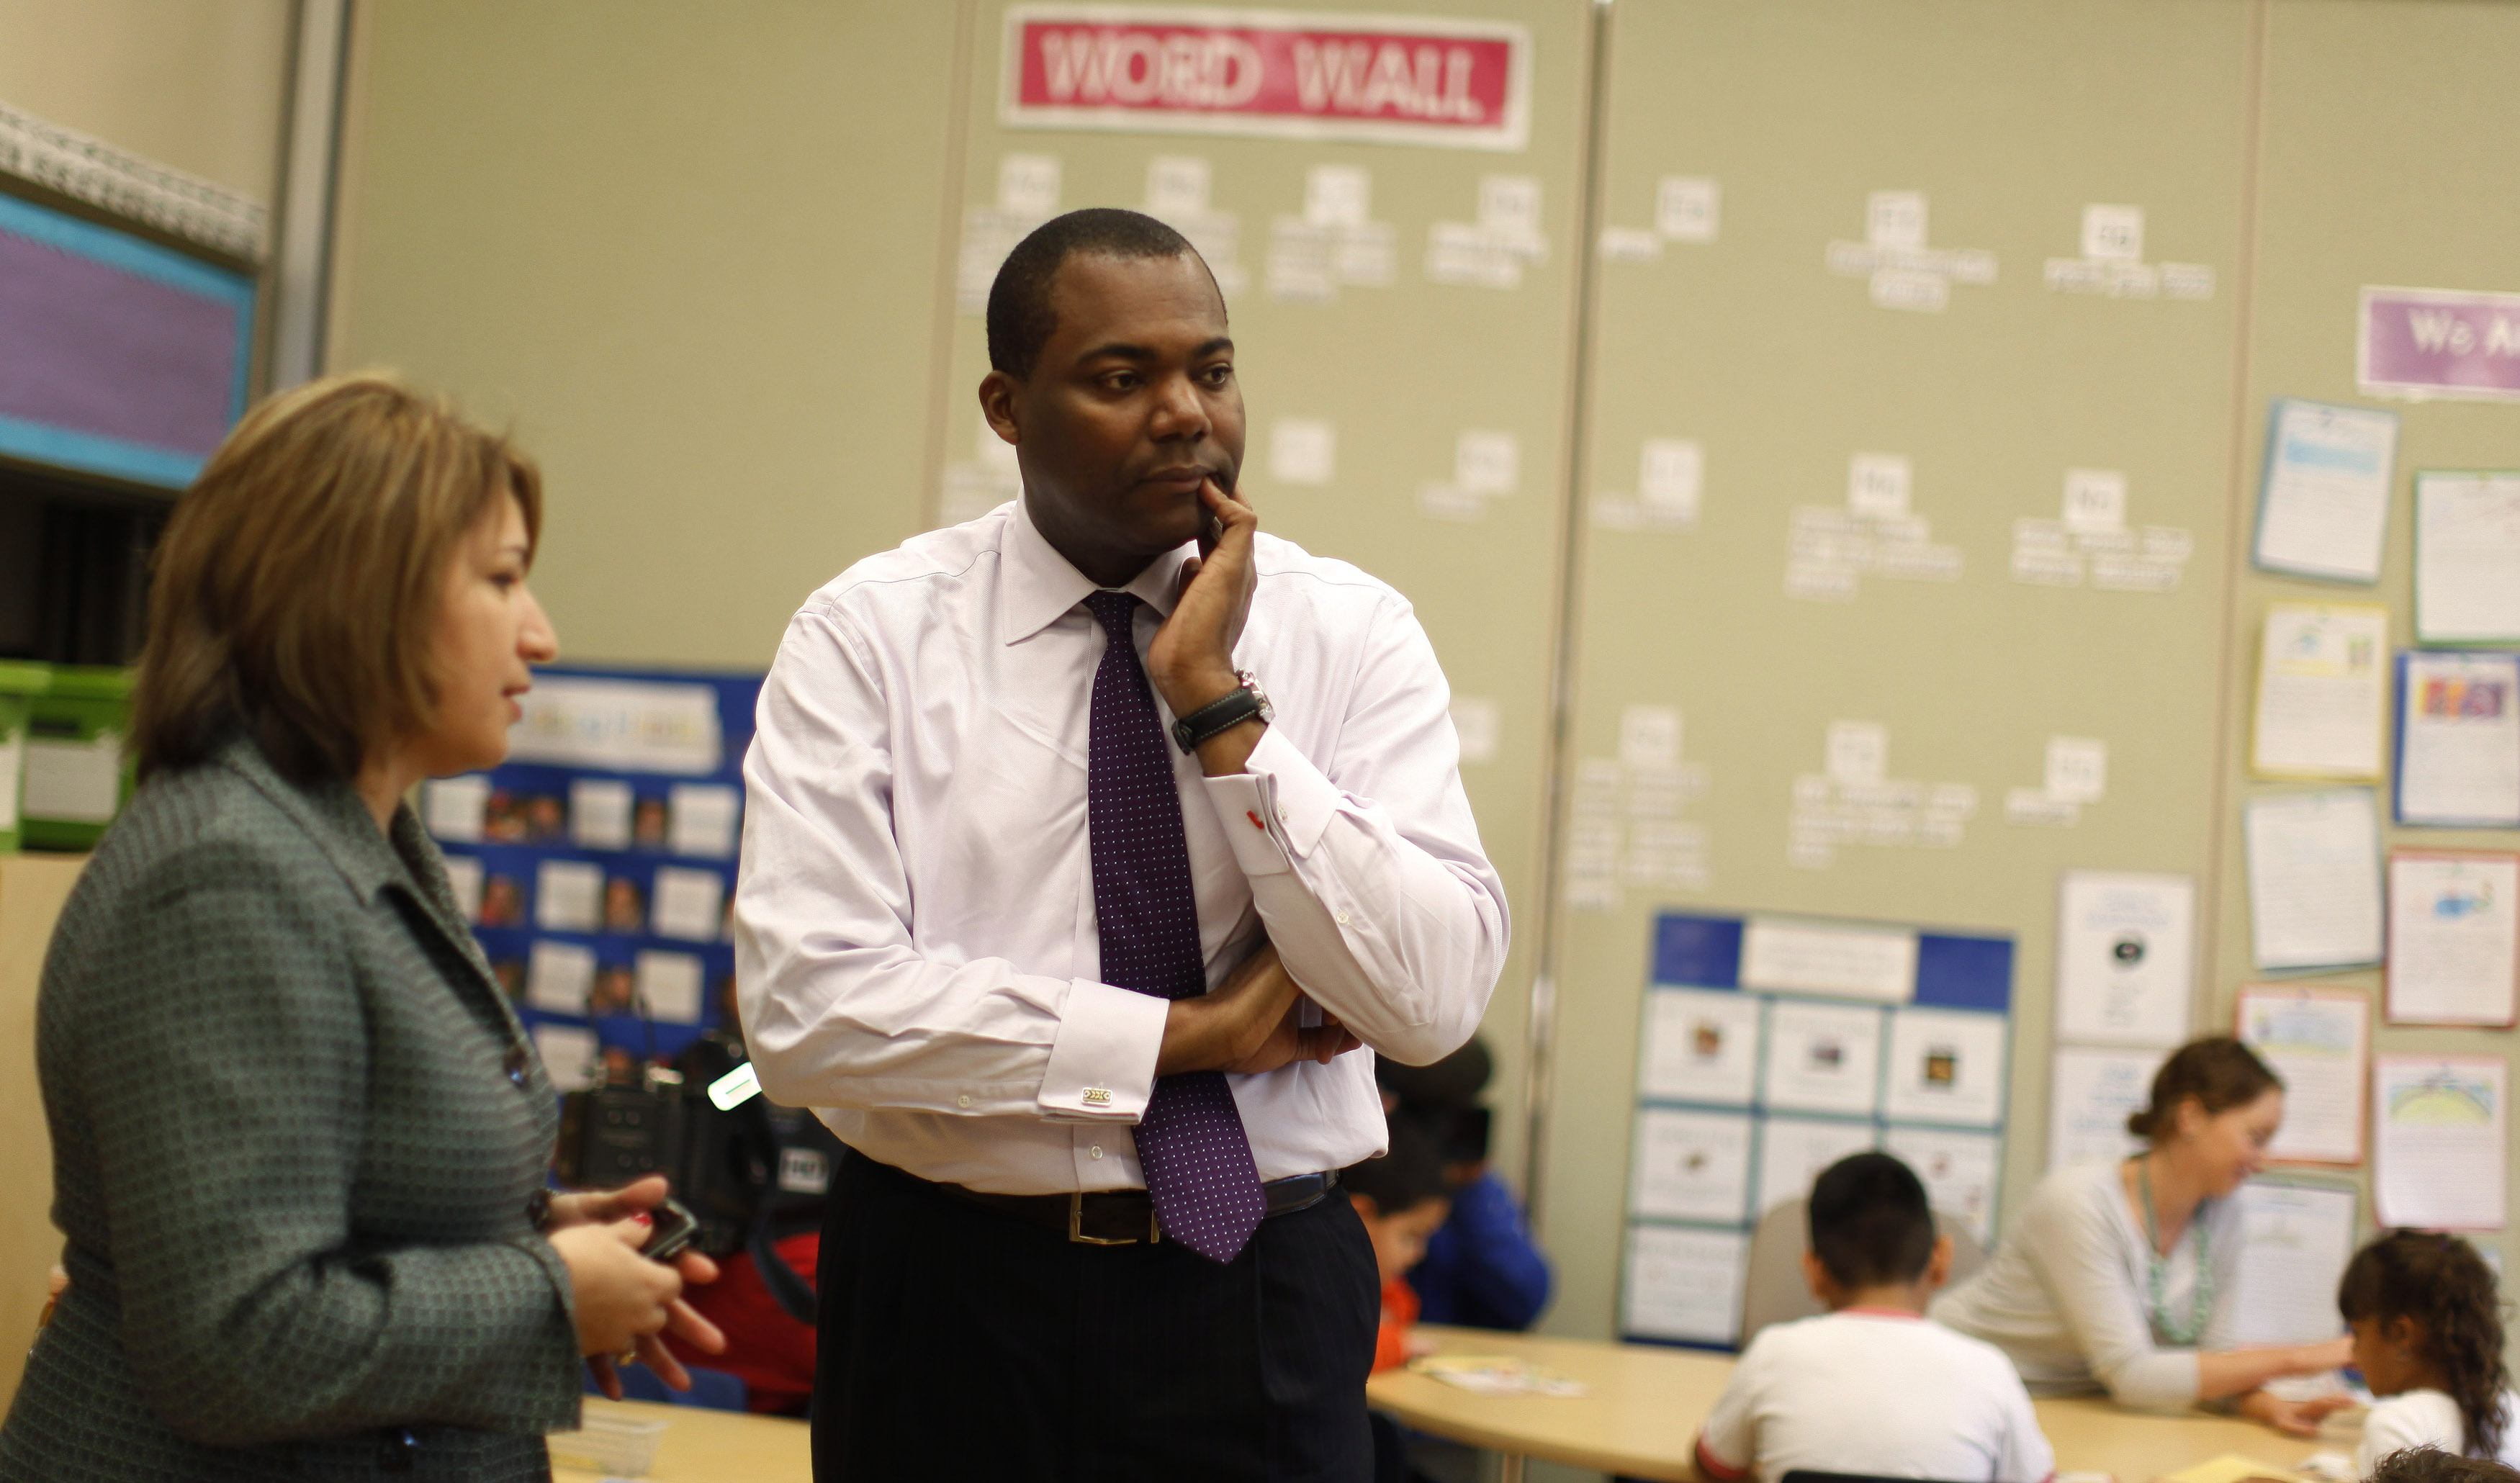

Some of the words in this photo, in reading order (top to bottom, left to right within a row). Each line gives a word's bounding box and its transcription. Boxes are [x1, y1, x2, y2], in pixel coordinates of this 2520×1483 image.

[1041, 31, 1264, 107] WORD
[1293, 39, 1485, 123] WALL
[2408, 308, 2475, 356] We
